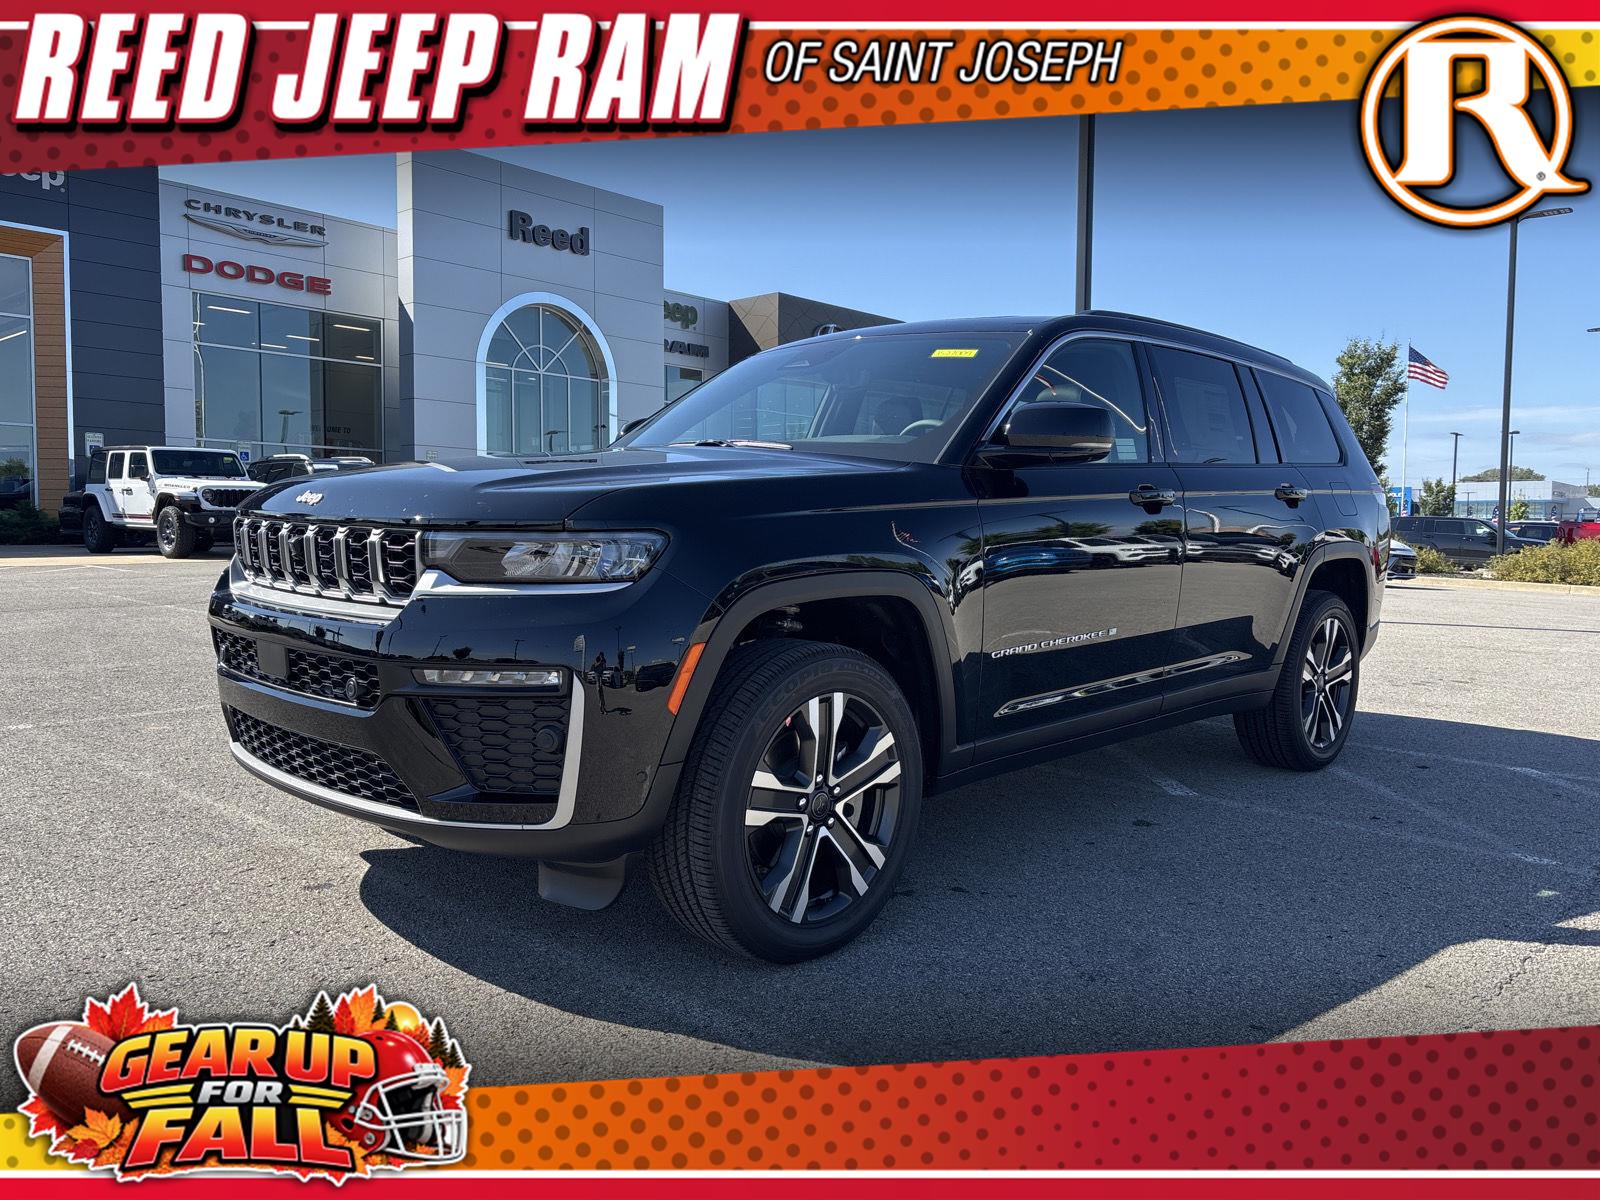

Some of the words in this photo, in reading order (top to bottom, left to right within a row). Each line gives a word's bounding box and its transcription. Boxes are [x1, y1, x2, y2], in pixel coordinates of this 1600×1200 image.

[184, 198, 326, 237] CHRYSLER
[507, 209, 590, 256] Reed
[182, 253, 332, 296] DODGE
[295, 489, 323, 506] Jeep
[991, 643, 1038, 659] GRAND
[1040, 630, 1106, 649] CHEROKEE
